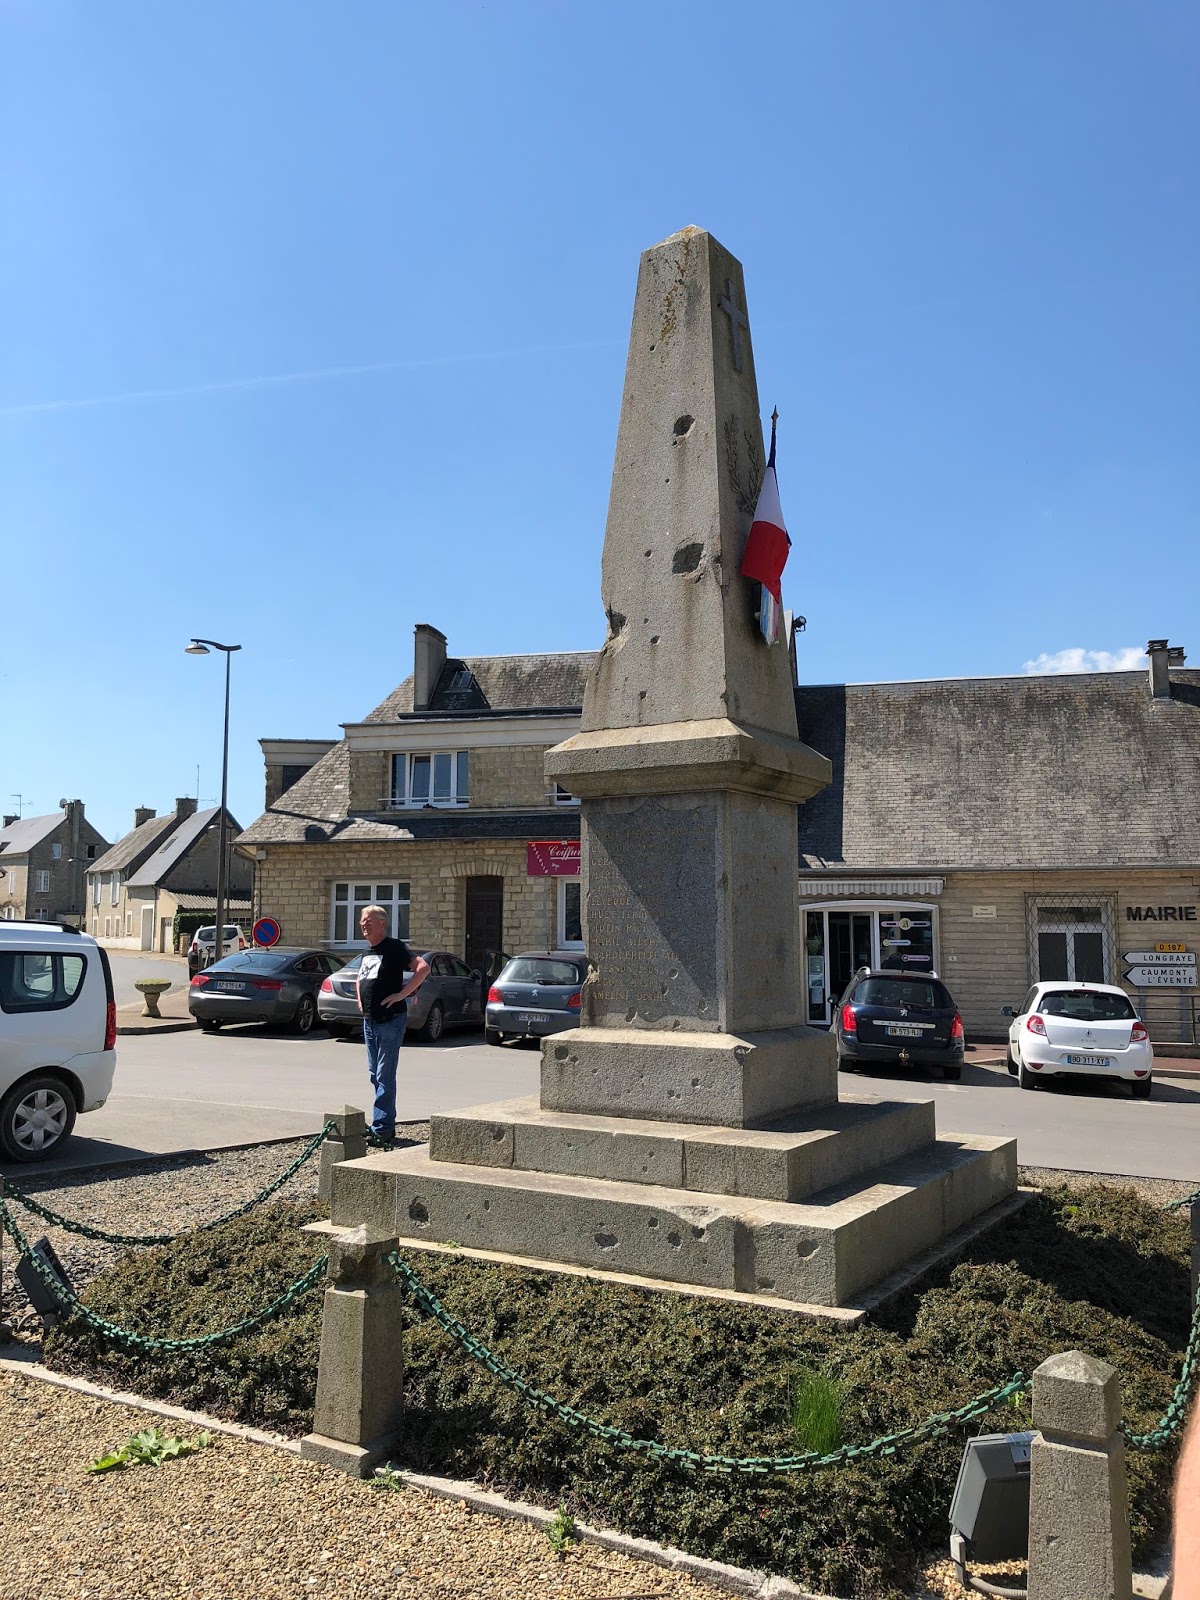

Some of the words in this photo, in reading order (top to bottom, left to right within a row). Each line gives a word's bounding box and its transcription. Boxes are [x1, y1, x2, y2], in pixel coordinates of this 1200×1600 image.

[549, 846, 581, 860] Coiffur
[1126, 906, 1198, 921] MAIRIE
[1143, 954, 1193, 962] LONGRAYE
